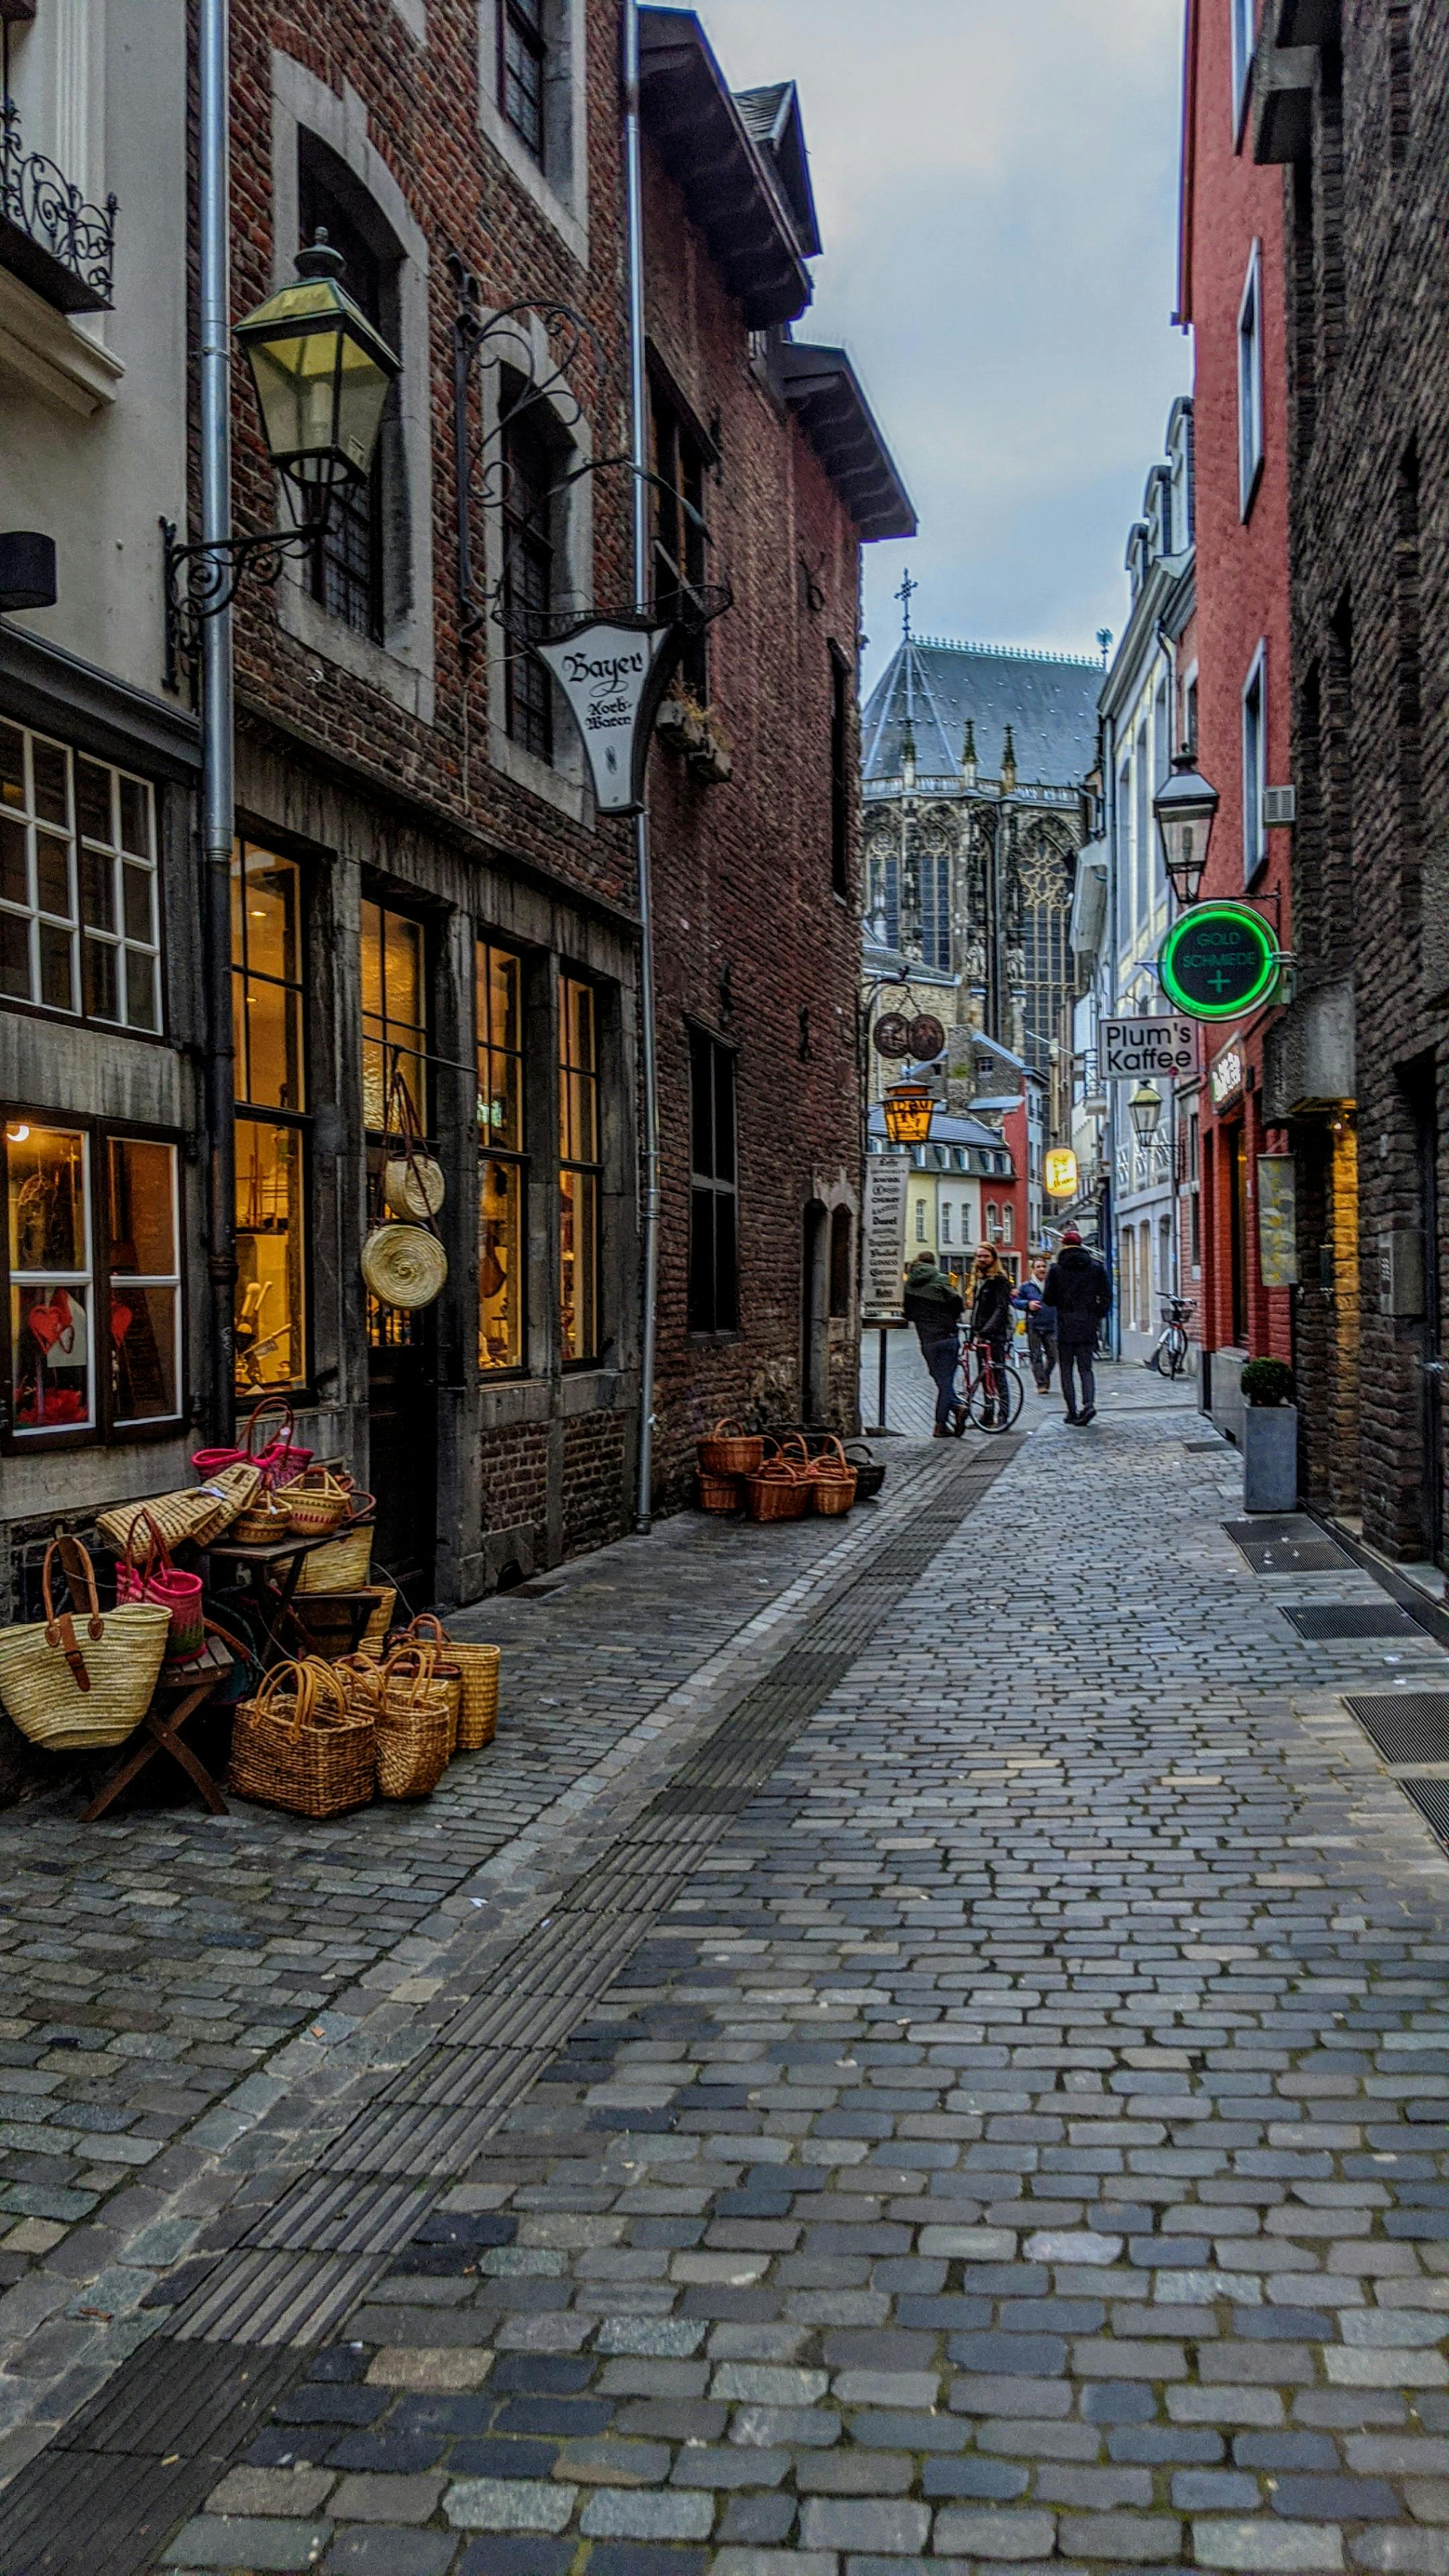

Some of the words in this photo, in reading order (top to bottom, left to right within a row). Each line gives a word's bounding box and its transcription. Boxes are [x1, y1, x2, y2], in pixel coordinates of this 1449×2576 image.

[1197, 932, 1240, 947] GOLD
[1182, 952, 1256, 968] SCHMIEDE
[1107, 1022, 1191, 1048] Plum's
[1108, 1048, 1191, 1071] Kaffee
